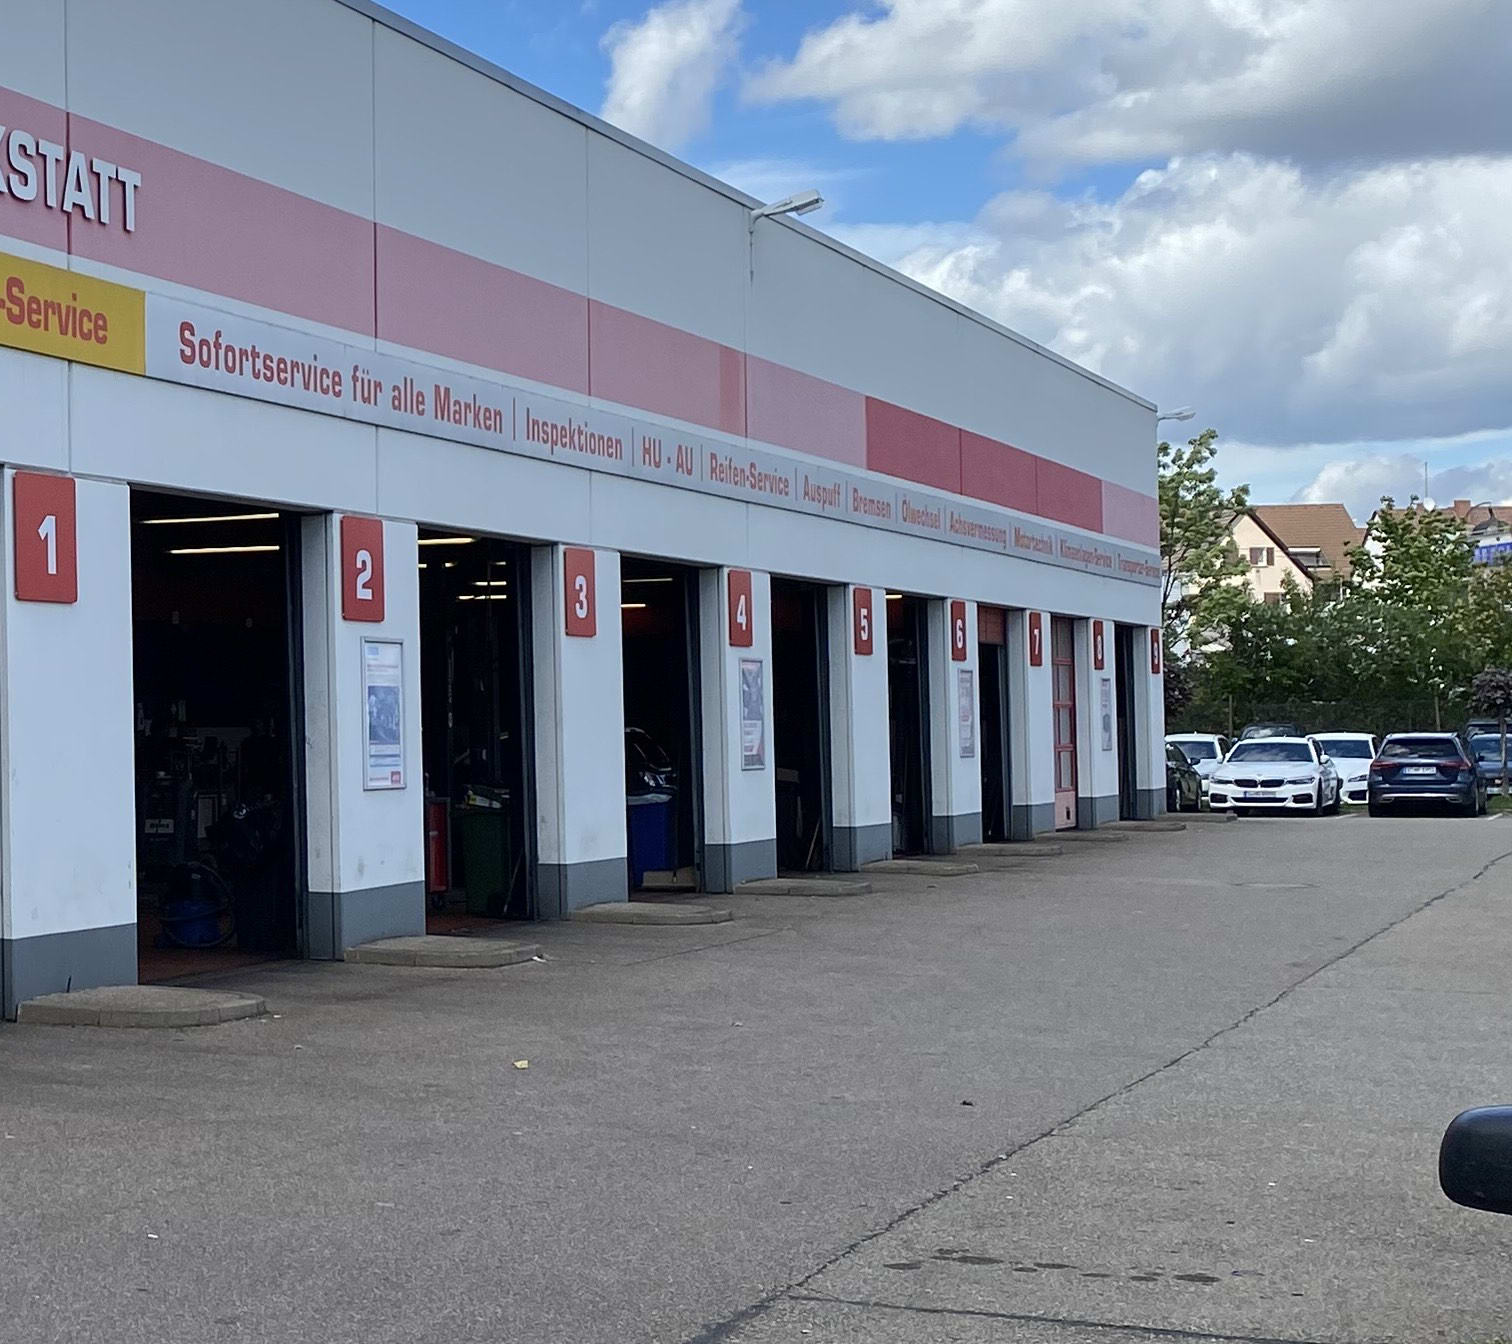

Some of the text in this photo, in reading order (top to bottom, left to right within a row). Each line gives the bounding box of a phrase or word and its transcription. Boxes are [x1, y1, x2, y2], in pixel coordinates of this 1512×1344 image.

[178, 320, 343, 399] Sofortservice
[351, 364, 383, 407] für
[391, 376, 426, 417] alle
[433, 384, 504, 435] Marken
[525, 407, 624, 461] Inspektionen
[642, 435, 662, 469] HU
[675, 444, 694, 476] AU
[710, 452, 790, 497] Reifen-Service
[803, 474, 841, 512] Auspuff
[852, 487, 892, 520] Bremsen
[37, 514, 58, 575] 1
[355, 549, 374, 601] 2
[574, 574, 589, 619] 3
[736, 594, 748, 632] 4
[860, 608, 870, 641] 5
[955, 619, 964, 649] 6
[1033, 628, 1040, 655] 7
[1096, 635, 1104, 661] 8
